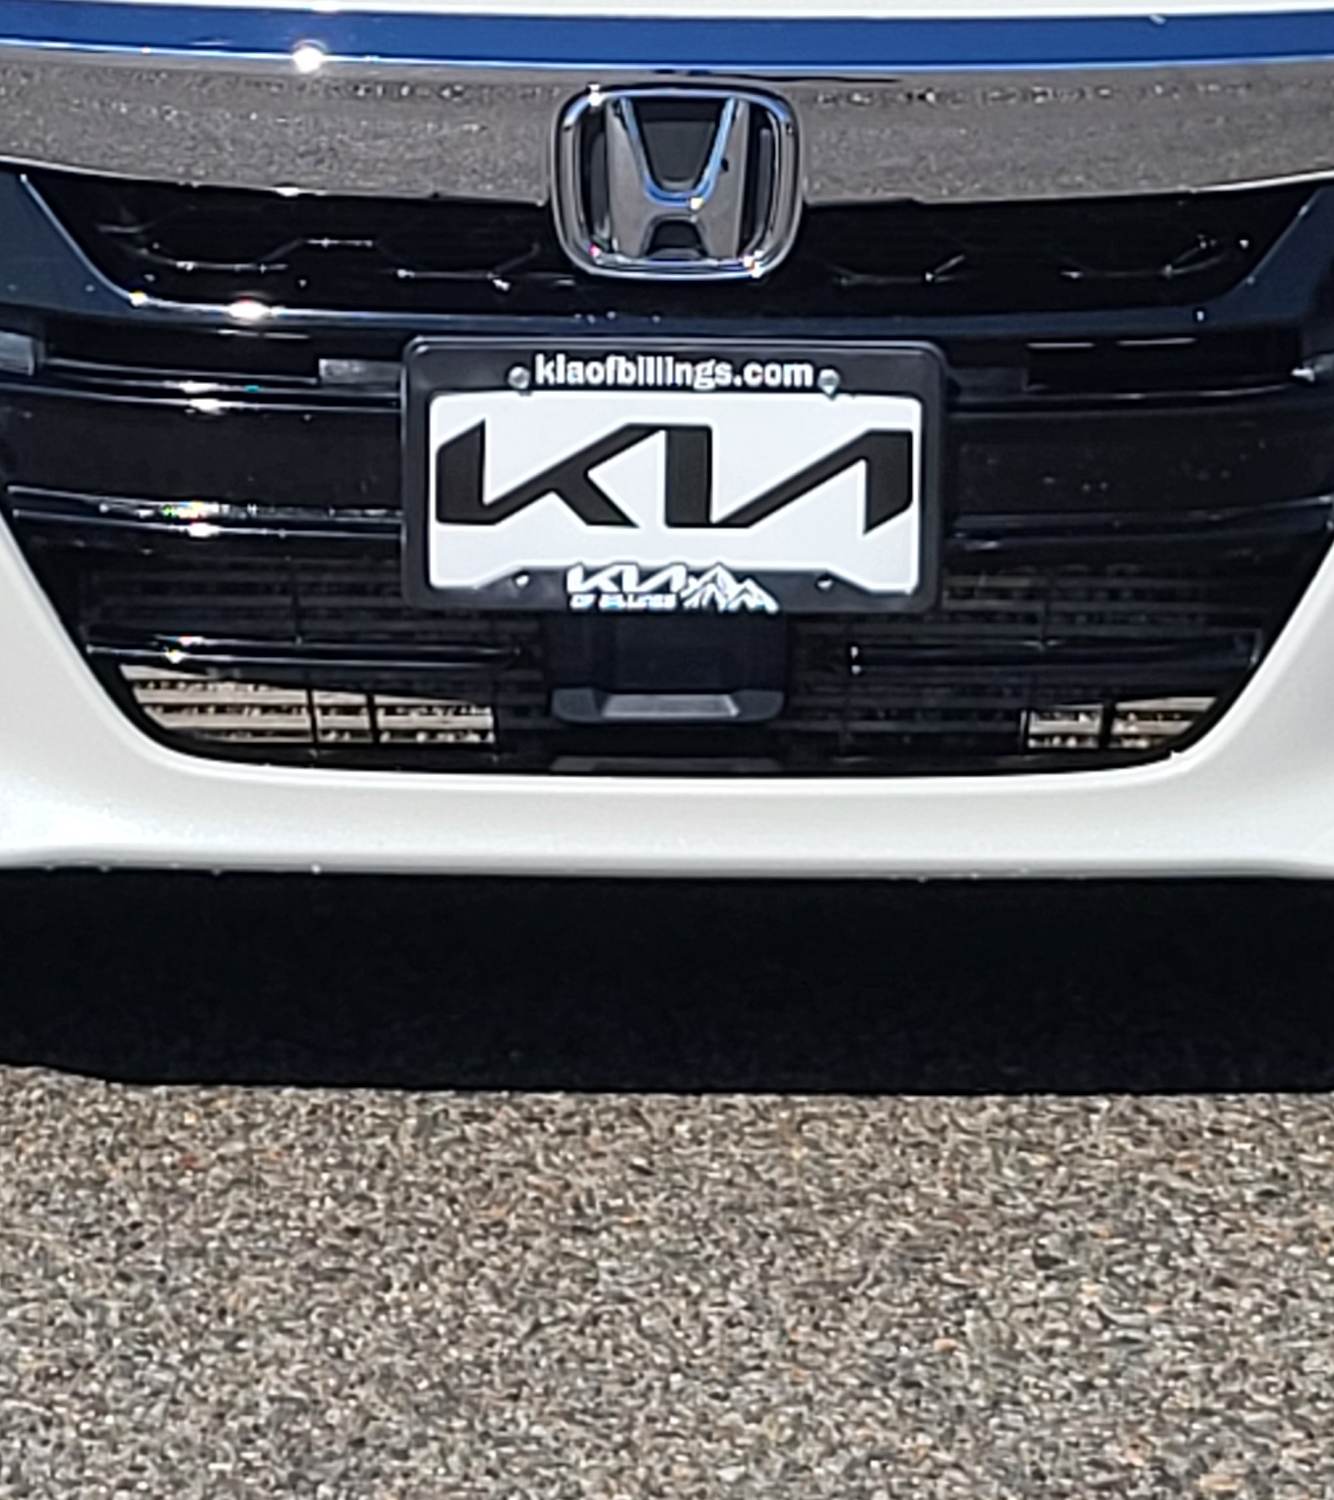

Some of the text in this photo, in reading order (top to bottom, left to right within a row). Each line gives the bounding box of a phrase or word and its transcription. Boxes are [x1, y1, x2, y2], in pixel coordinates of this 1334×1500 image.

[534, 353, 814, 391] kiaofbillings.com
[435, 418, 914, 535] KIA
[567, 563, 688, 594] KIA
